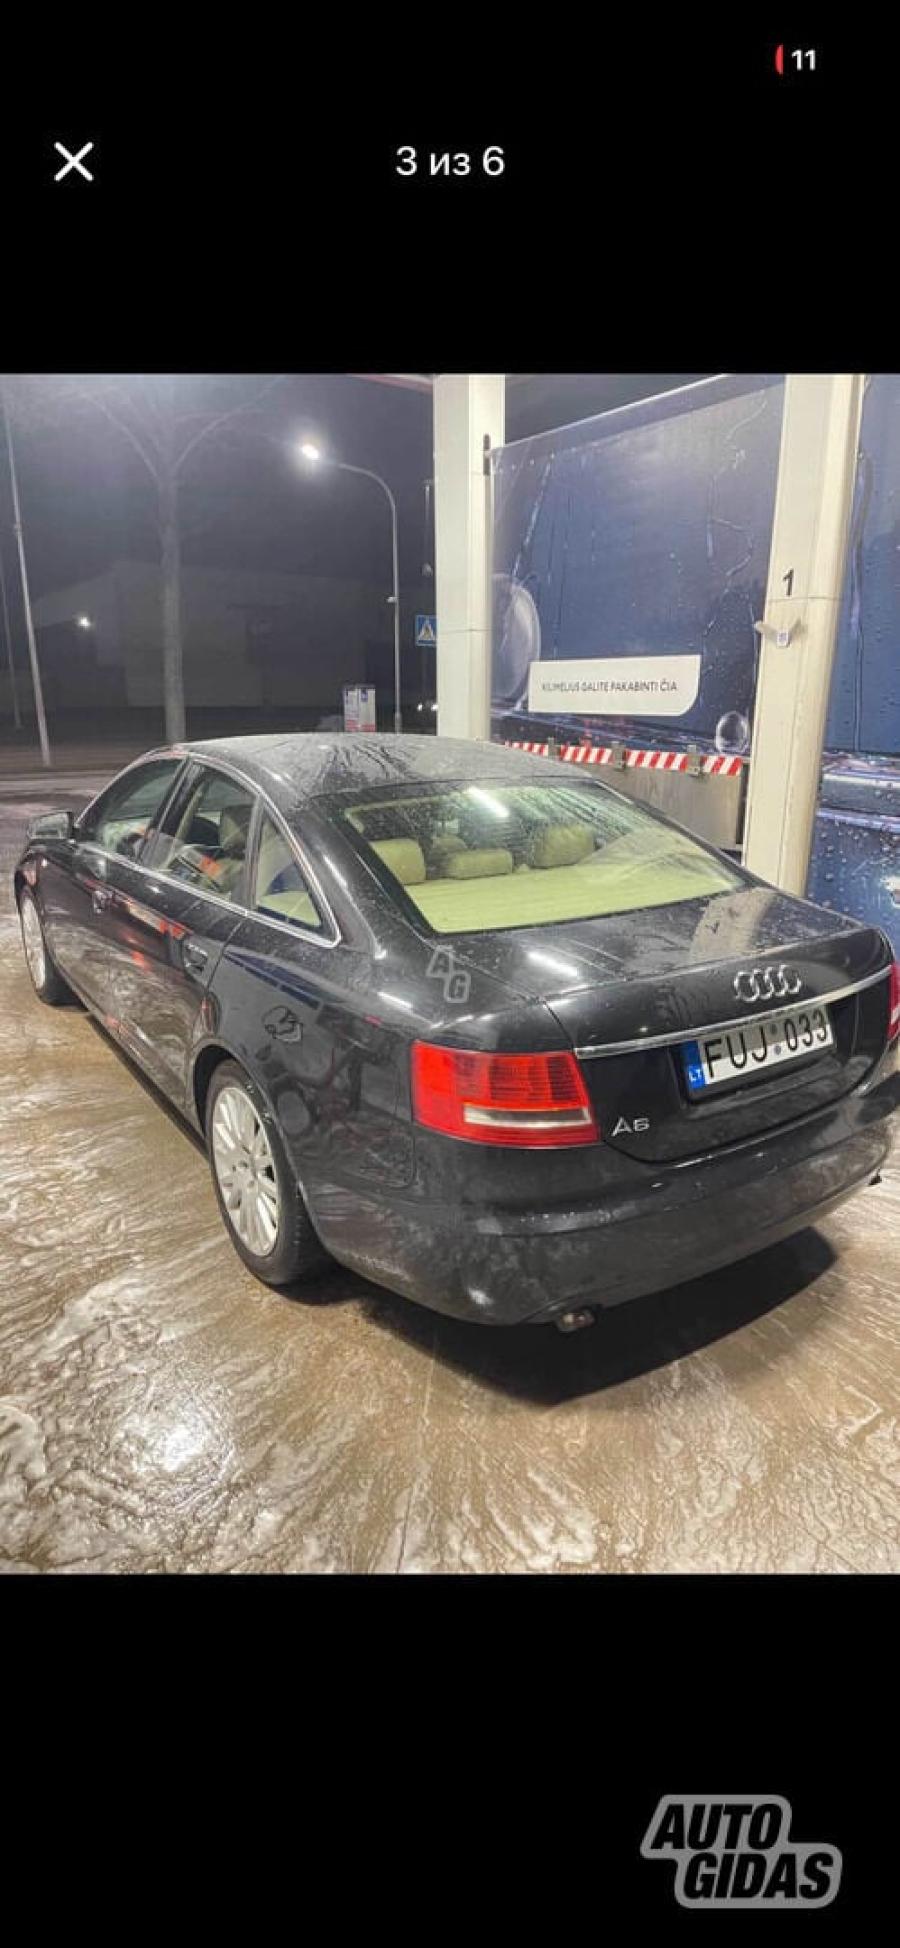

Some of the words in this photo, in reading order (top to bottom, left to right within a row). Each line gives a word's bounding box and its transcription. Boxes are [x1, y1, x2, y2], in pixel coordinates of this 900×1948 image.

[783, 568, 794, 596] 1
[610, 680, 659, 692] PAKABINTI
[660, 677, 677, 692] ČIA
[703, 1025, 767, 1078] FUJ
[783, 1009, 828, 1051] 033
[611, 1116, 650, 1137] A6
